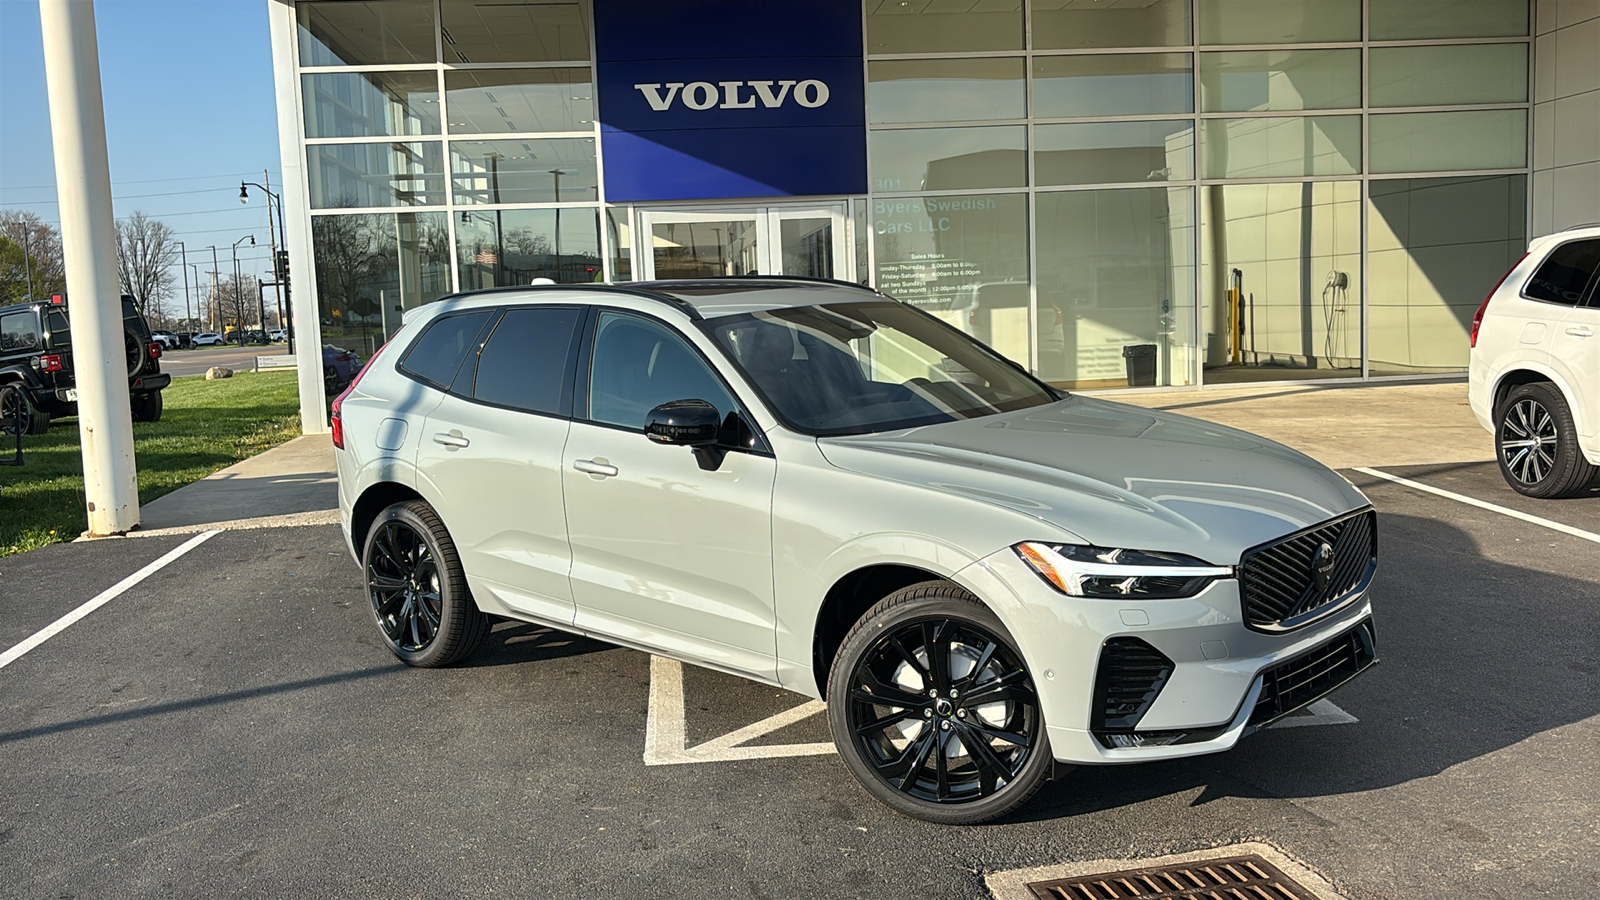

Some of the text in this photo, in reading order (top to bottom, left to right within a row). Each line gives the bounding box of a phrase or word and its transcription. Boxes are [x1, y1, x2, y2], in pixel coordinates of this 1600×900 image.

[634, 79, 830, 111] VOLVO
[877, 179, 901, 191] 301
[875, 197, 996, 217] Byers Swedish
[875, 217, 951, 234] Cars LLC
[880, 264, 926, 272] onday-Thursday
[881, 272, 926, 280] Friday-Saturday
